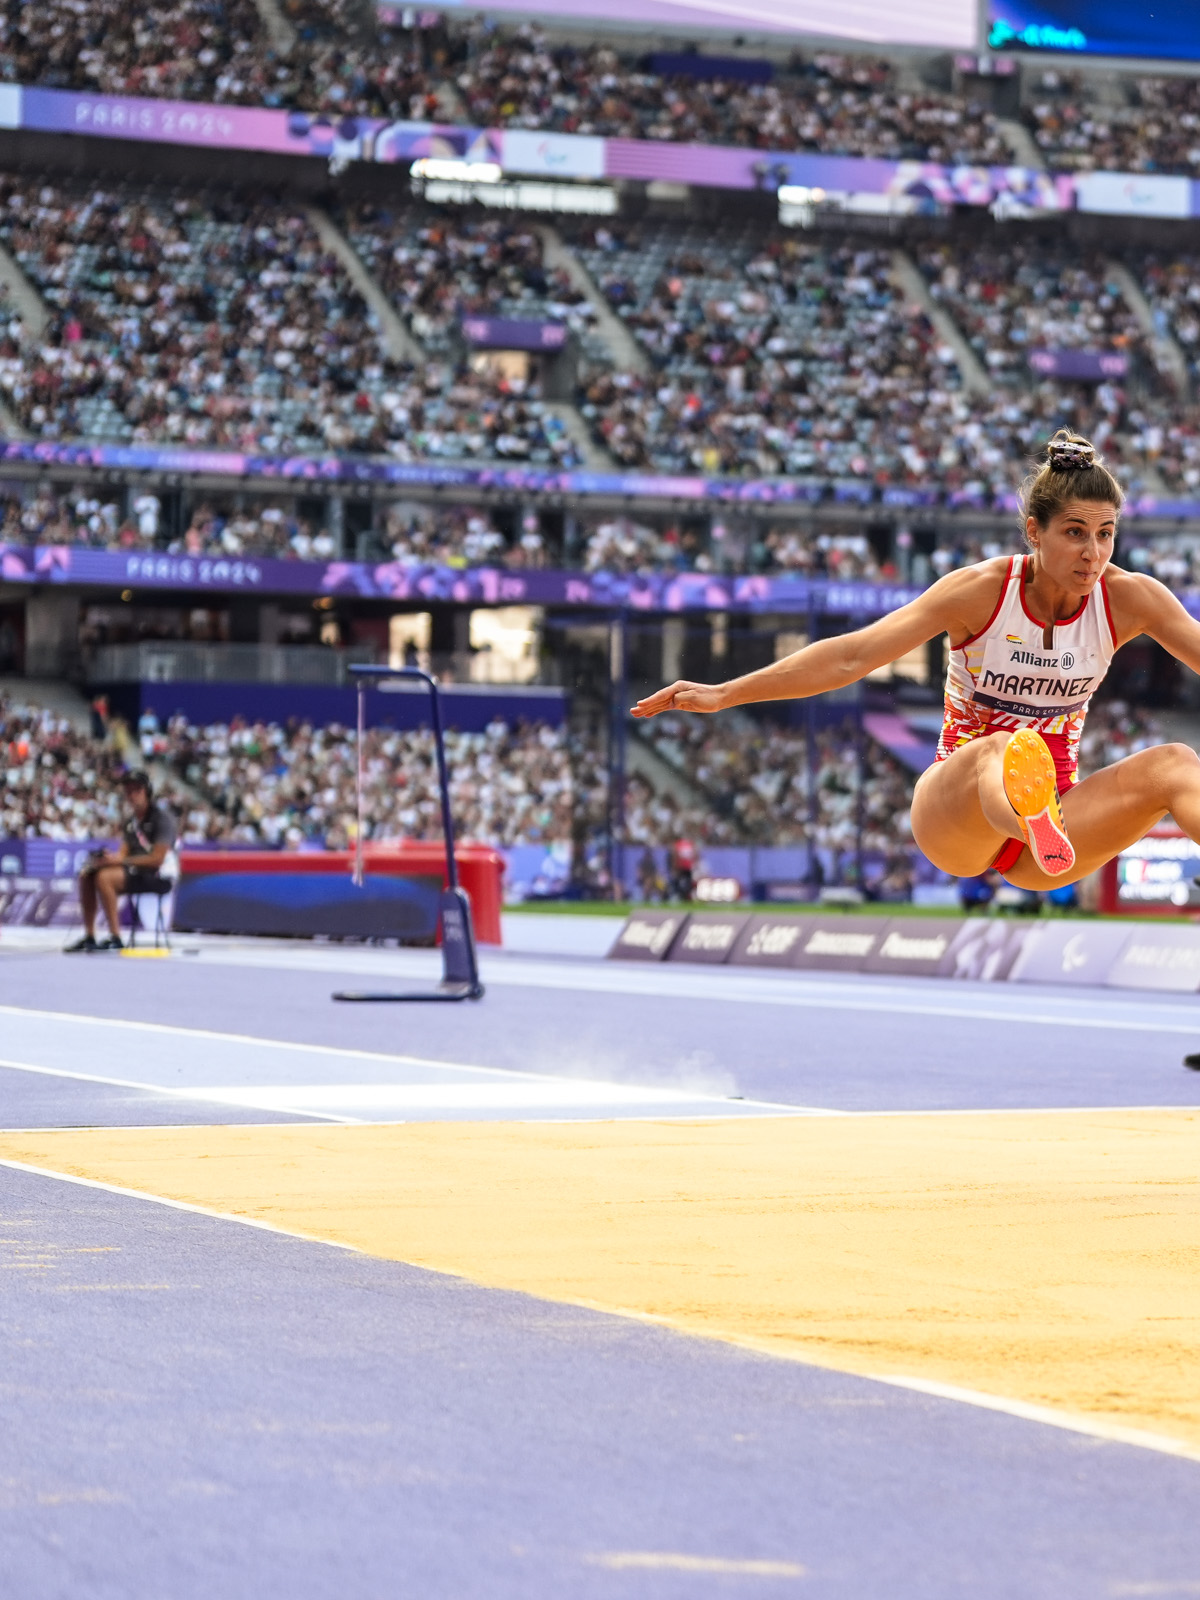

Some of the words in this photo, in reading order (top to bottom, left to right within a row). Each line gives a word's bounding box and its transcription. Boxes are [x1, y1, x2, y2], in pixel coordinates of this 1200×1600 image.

[75, 102, 154, 132] PARIS
[160, 109, 234, 138] 2024
[126, 556, 194, 583] PARIS
[198, 560, 262, 586] 2024
[1010, 650, 1058, 668] Allianz
[982, 669, 1095, 697] MARTINEZ
[1012, 703, 1040, 716] PARIS
